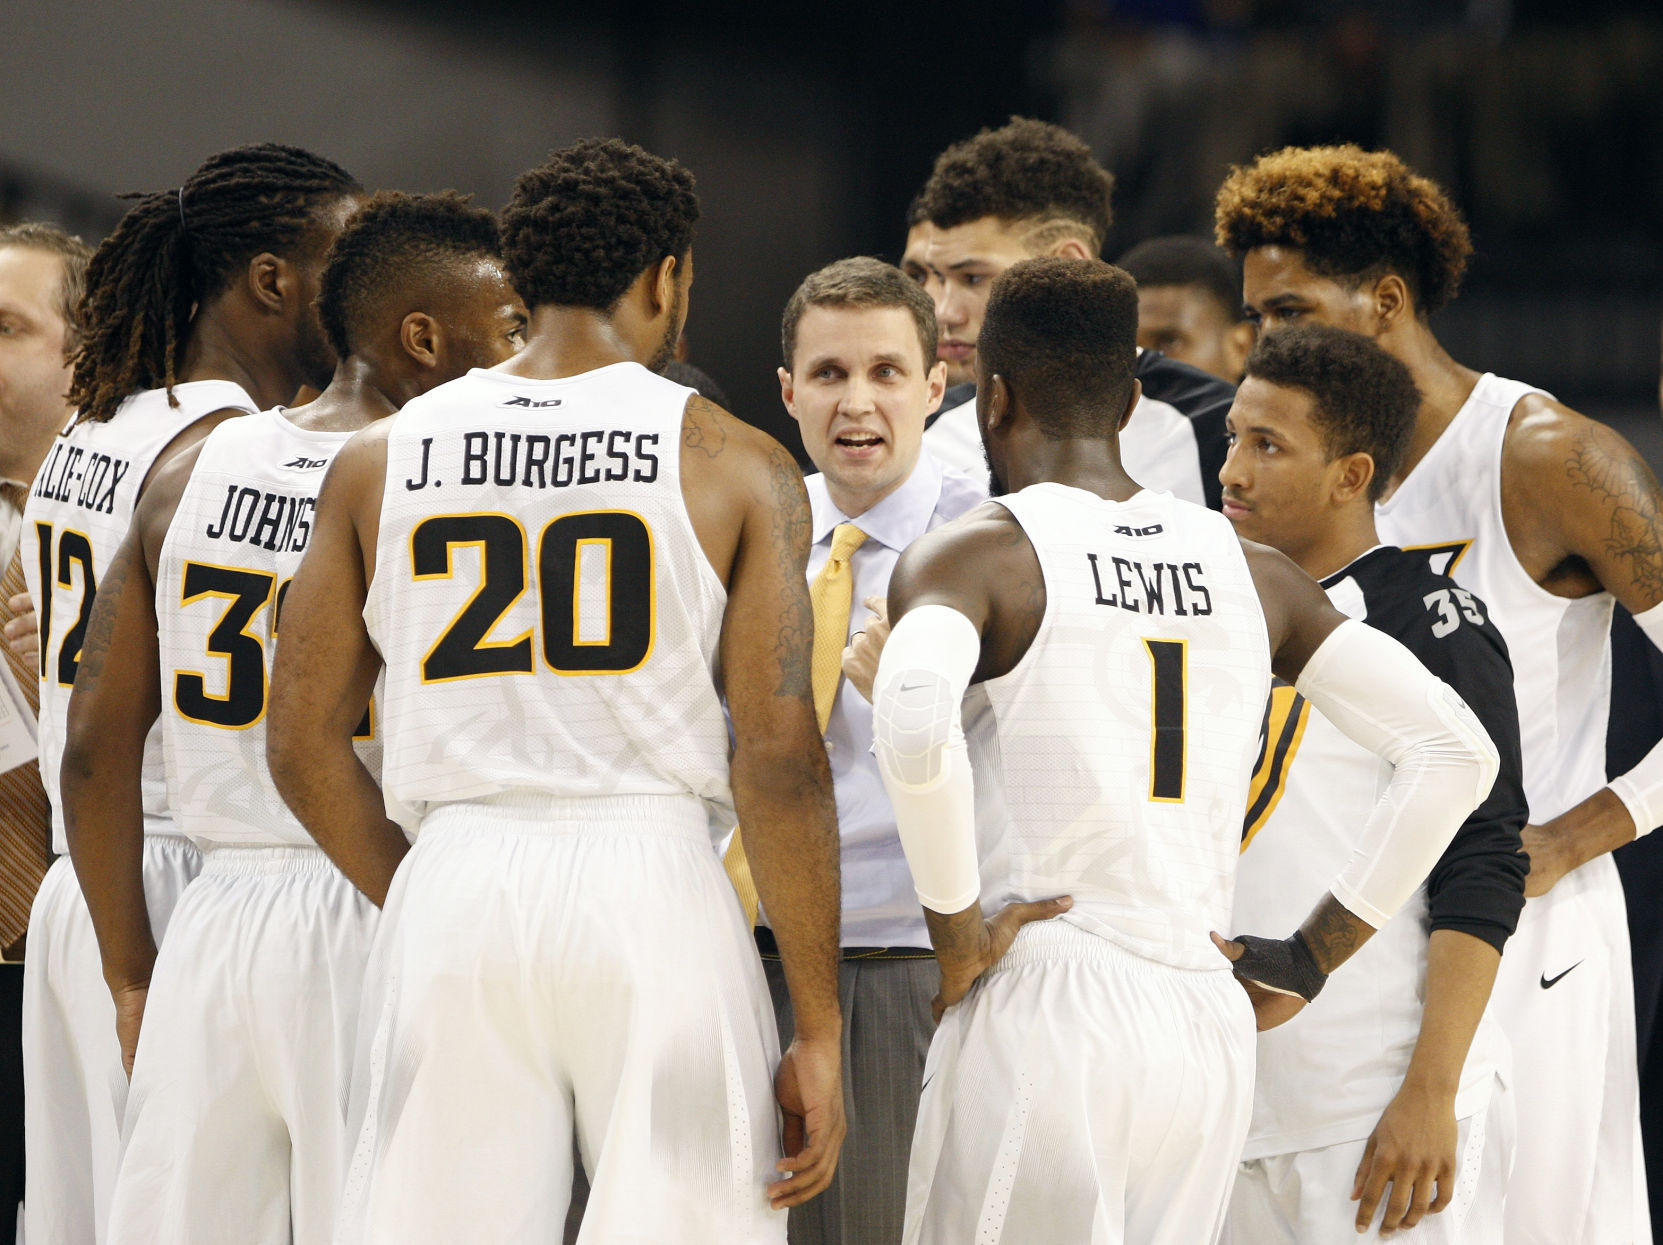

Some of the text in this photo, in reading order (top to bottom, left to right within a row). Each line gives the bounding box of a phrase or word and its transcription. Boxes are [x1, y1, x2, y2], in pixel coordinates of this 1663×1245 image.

[502, 395, 562, 407] A10
[405, 430, 660, 491] J. BURGESS
[1112, 523, 1164, 537] A10
[34, 520, 98, 689] 12
[408, 508, 656, 685] 20
[1087, 553, 1213, 616] LEWIS
[1422, 588, 1485, 639] 35
[1140, 636, 1188, 804] 1
